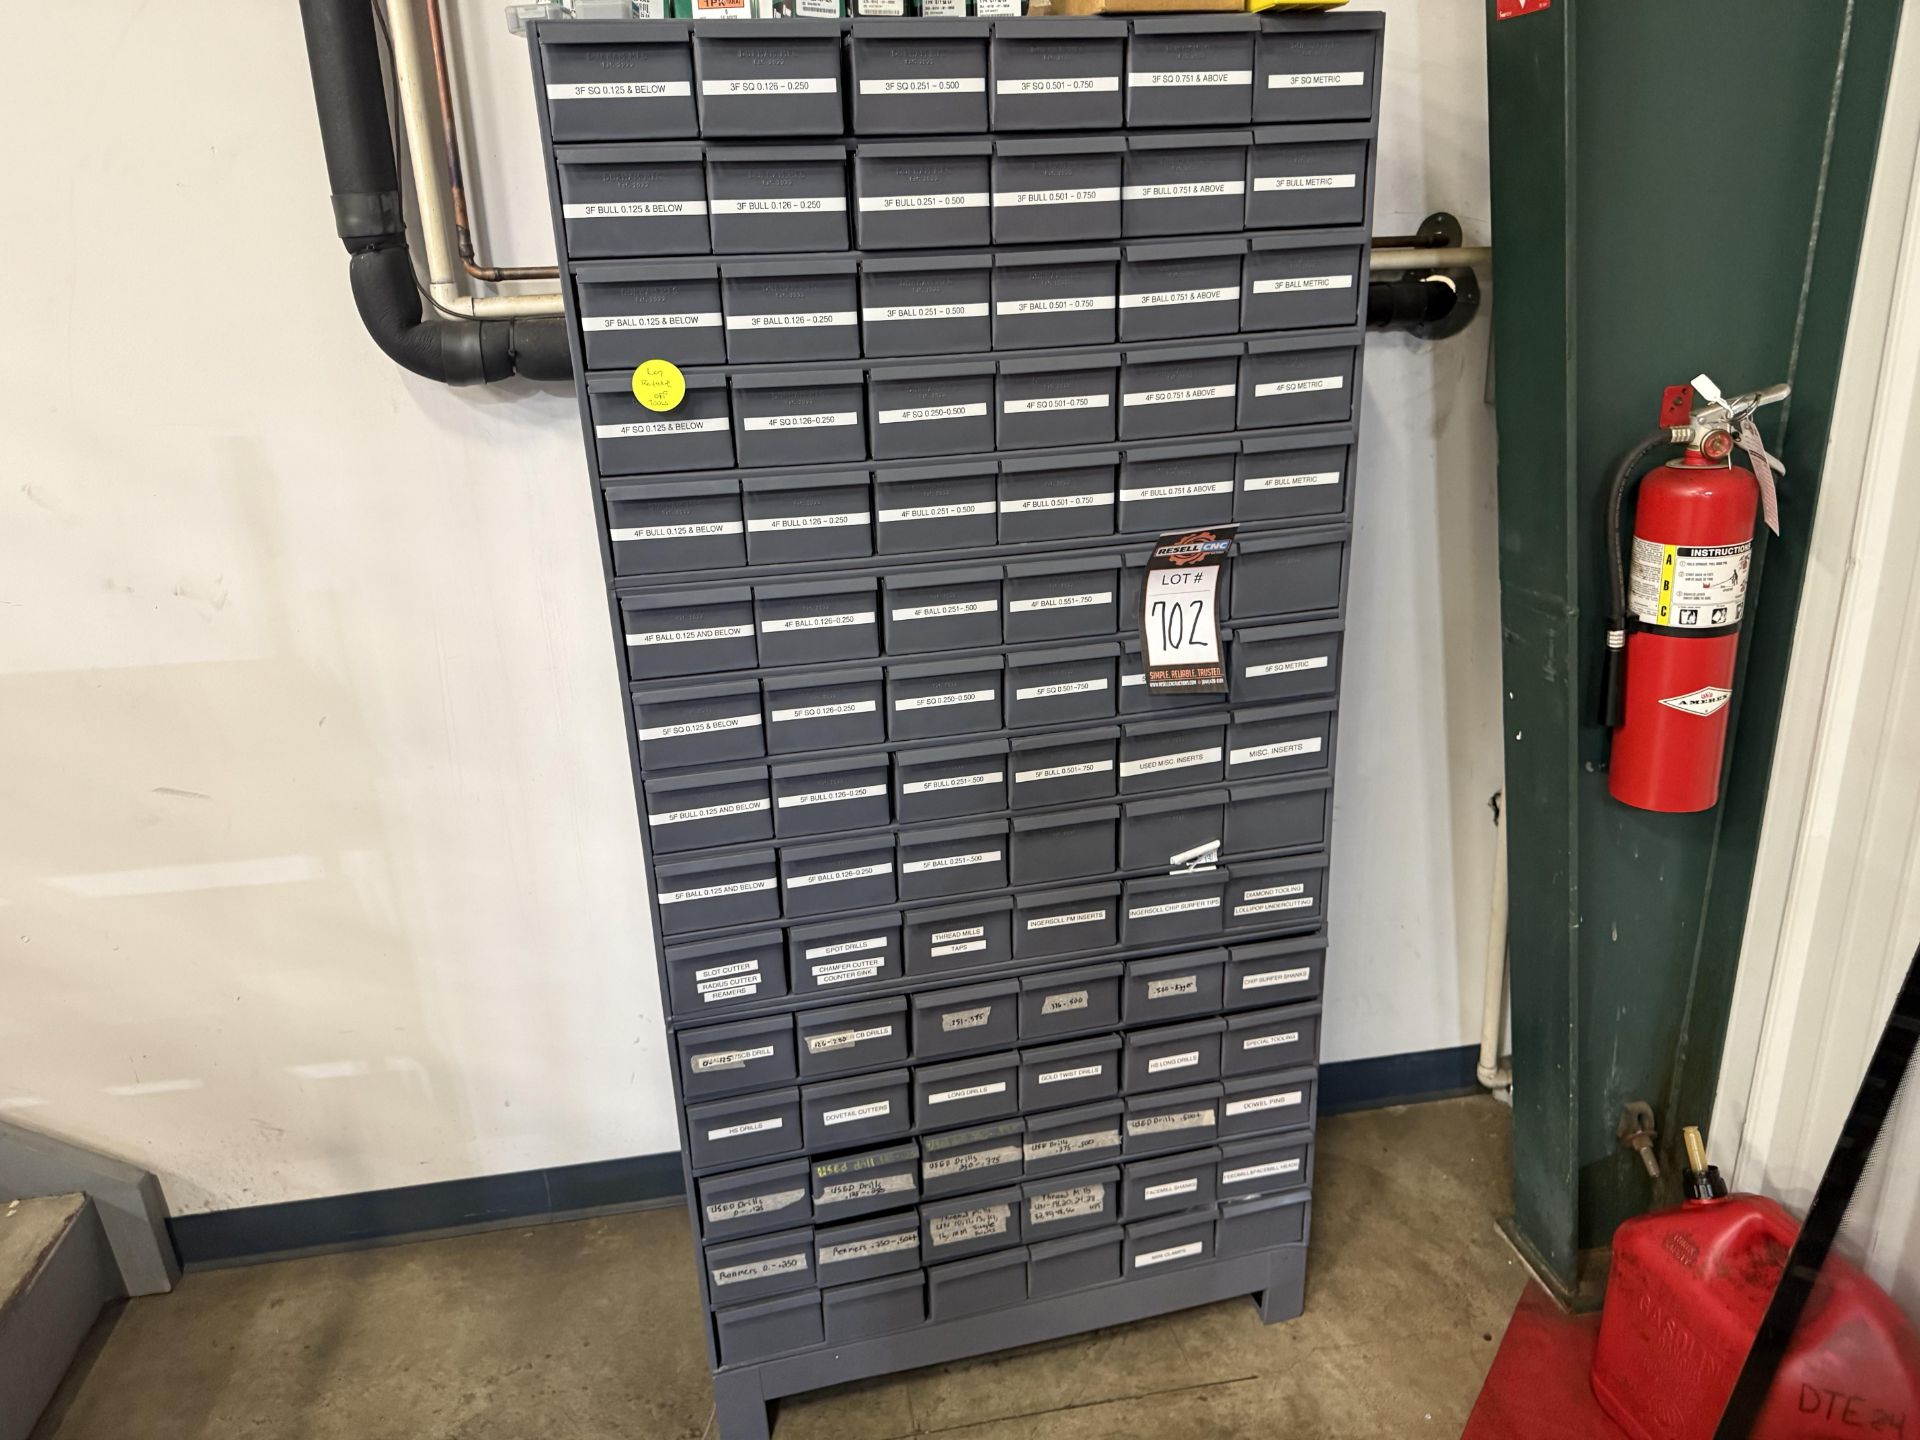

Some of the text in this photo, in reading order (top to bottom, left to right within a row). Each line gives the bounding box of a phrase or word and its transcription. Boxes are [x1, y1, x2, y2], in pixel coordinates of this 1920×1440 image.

[1152, 73, 1228, 83] 3F SQ 0.751 & ABOVE
[1290, 75, 1340, 84] 3F SQ METRIC
[575, 84, 665, 95] 3F SQ 0.125 & BELOW
[1275, 177, 1332, 187] 3F BULL METRIC
[1142, 184, 1224, 195] 3F BULL 0.751 & ABOVE
[585, 203, 682, 214] 3F BULL 0.125 & BELOW
[1284, 280, 1301, 288] BALL
[1302, 279, 1329, 287] METRIC
[1141, 291, 1220, 303] 3F BALL 0.751 & ABOVE
[604, 316, 698, 327] 3F BALL 0.125 & BELOW
[1297, 381, 1323, 389] METRIC
[1145, 389, 1215, 401] 4F SQ 0.751 & ABOVE
[620, 421, 703, 433] 4F SQ 0.125 & BELOW
[1291, 476, 1317, 484] METRIC
[1149, 488, 1167, 496] BULL
[1193, 485, 1216, 493] ABOVE
[634, 524, 723, 537] 4F BULL 0.125 & BELOW
[1158, 542, 1228, 555] RESELL CNC
[1665, 554, 1672, 565] A
[1161, 572, 1203, 585] LOT #
[1663, 580, 1670, 591] B
[1660, 606, 1667, 616] C
[1151, 599, 1208, 651] 702
[655, 632, 674, 641] BALL
[675, 631, 695, 639] 0.125
[696, 630, 713, 638] AND
[714, 628, 740, 636] BELOW
[1284, 661, 1309, 670] METRIC
[662, 727, 671, 735] 5F
[685, 723, 704, 732] 0.125
[705, 722, 711, 730] &
[712, 719, 738, 729] BELOW
[1271, 744, 1303, 754] INSERTS
[1139, 760, 1157, 769] USED
[1176, 754, 1204, 764] INSERTS
[678, 810, 698, 819] BULL
[698, 807, 718, 816] 0.125
[718, 805, 734, 813] AND
[735, 801, 761, 811] BELOW
[684, 890, 703, 898] BALL
[703, 887, 722, 895] 0.125
[723, 885, 738, 893] AND
[739, 881, 765, 891] BELOW
[1030, 917, 1065, 926] INGERSOLL
[1076, 912, 1103, 920] INSERTS
[935, 928, 980, 940] THREAD MILLS
[825, 941, 868, 953] SPOT DRILLS
[702, 963, 750, 977] SLOT CUTTER
[818, 959, 878, 972] CHAMFER CUTTER
[823, 971, 855, 981] COUNTER
[702, 976, 758, 989] RADIUS CUTTER
[712, 988, 746, 998] REAMERS
[947, 1086, 988, 1098] LONG DRILLS
[825, 1104, 889, 1121] DOVETAIL CUTTERS
[728, 1122, 763, 1134] HS DRILLS
[1798, 1382, 1867, 1428] DTE
